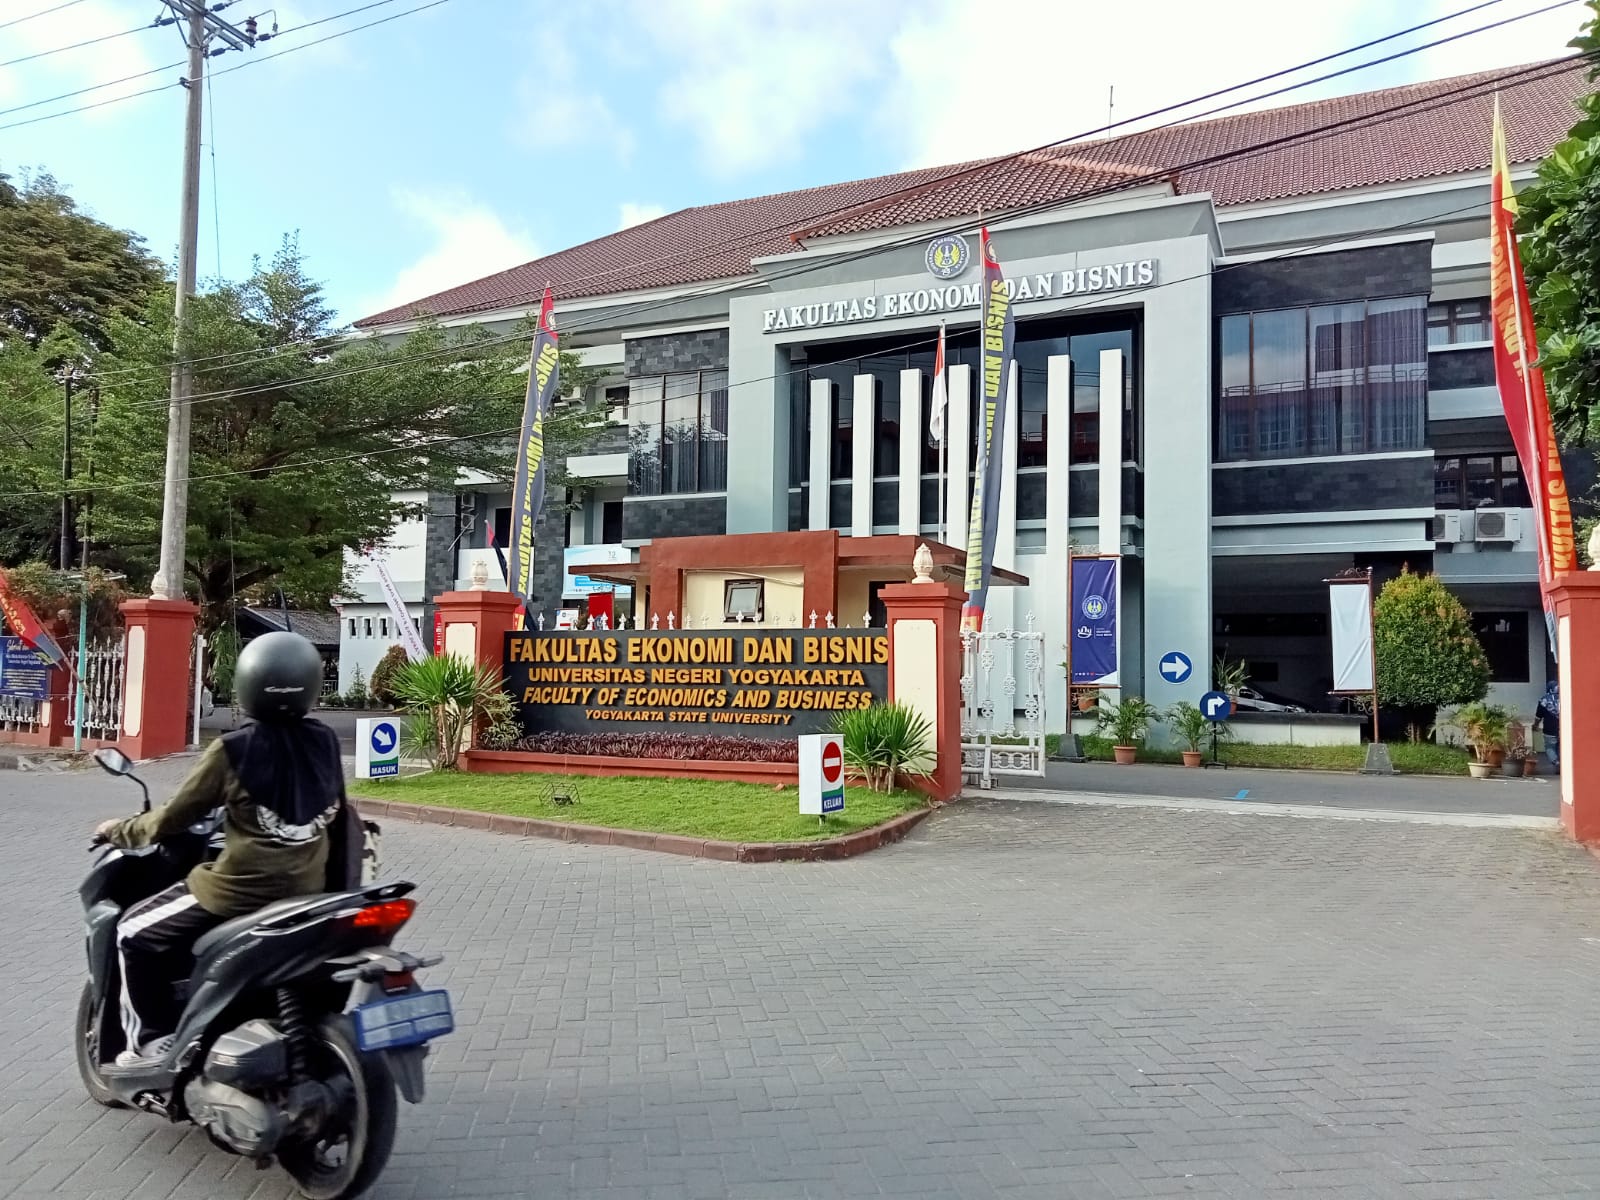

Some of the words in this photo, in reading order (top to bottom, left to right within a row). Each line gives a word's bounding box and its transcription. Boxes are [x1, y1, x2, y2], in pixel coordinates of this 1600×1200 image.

[762, 296, 876, 331] FAKULTAS
[883, 283, 981, 317] EKONOM
[1003, 272, 1054, 301] DAN
[1060, 259, 1154, 295] BISNIS
[985, 279, 1009, 352] BISNIS
[510, 637, 617, 663] FAKULTAS
[627, 637, 733, 664] EKONOMI
[743, 637, 793, 664] DAN
[803, 636, 888, 664] BISNIS
[528, 667, 646, 684] UNIVERSITAS
[651, 668, 721, 685] NEGERI
[728, 668, 865, 686] YOGYAKARTA
[523, 686, 594, 704] FACULTY
[599, 687, 620, 706] OF
[624, 687, 728, 708] ECONOMICS
[731, 689, 771, 709] AND
[775, 689, 873, 710] BUSINESS
[585, 709, 665, 721] YOGYAKARTA
[668, 711, 707, 723] STATE
[711, 712, 791, 725] UNIVERSITY
[371, 766, 396, 775] MASUK
[823, 797, 842, 809] KELUAR
